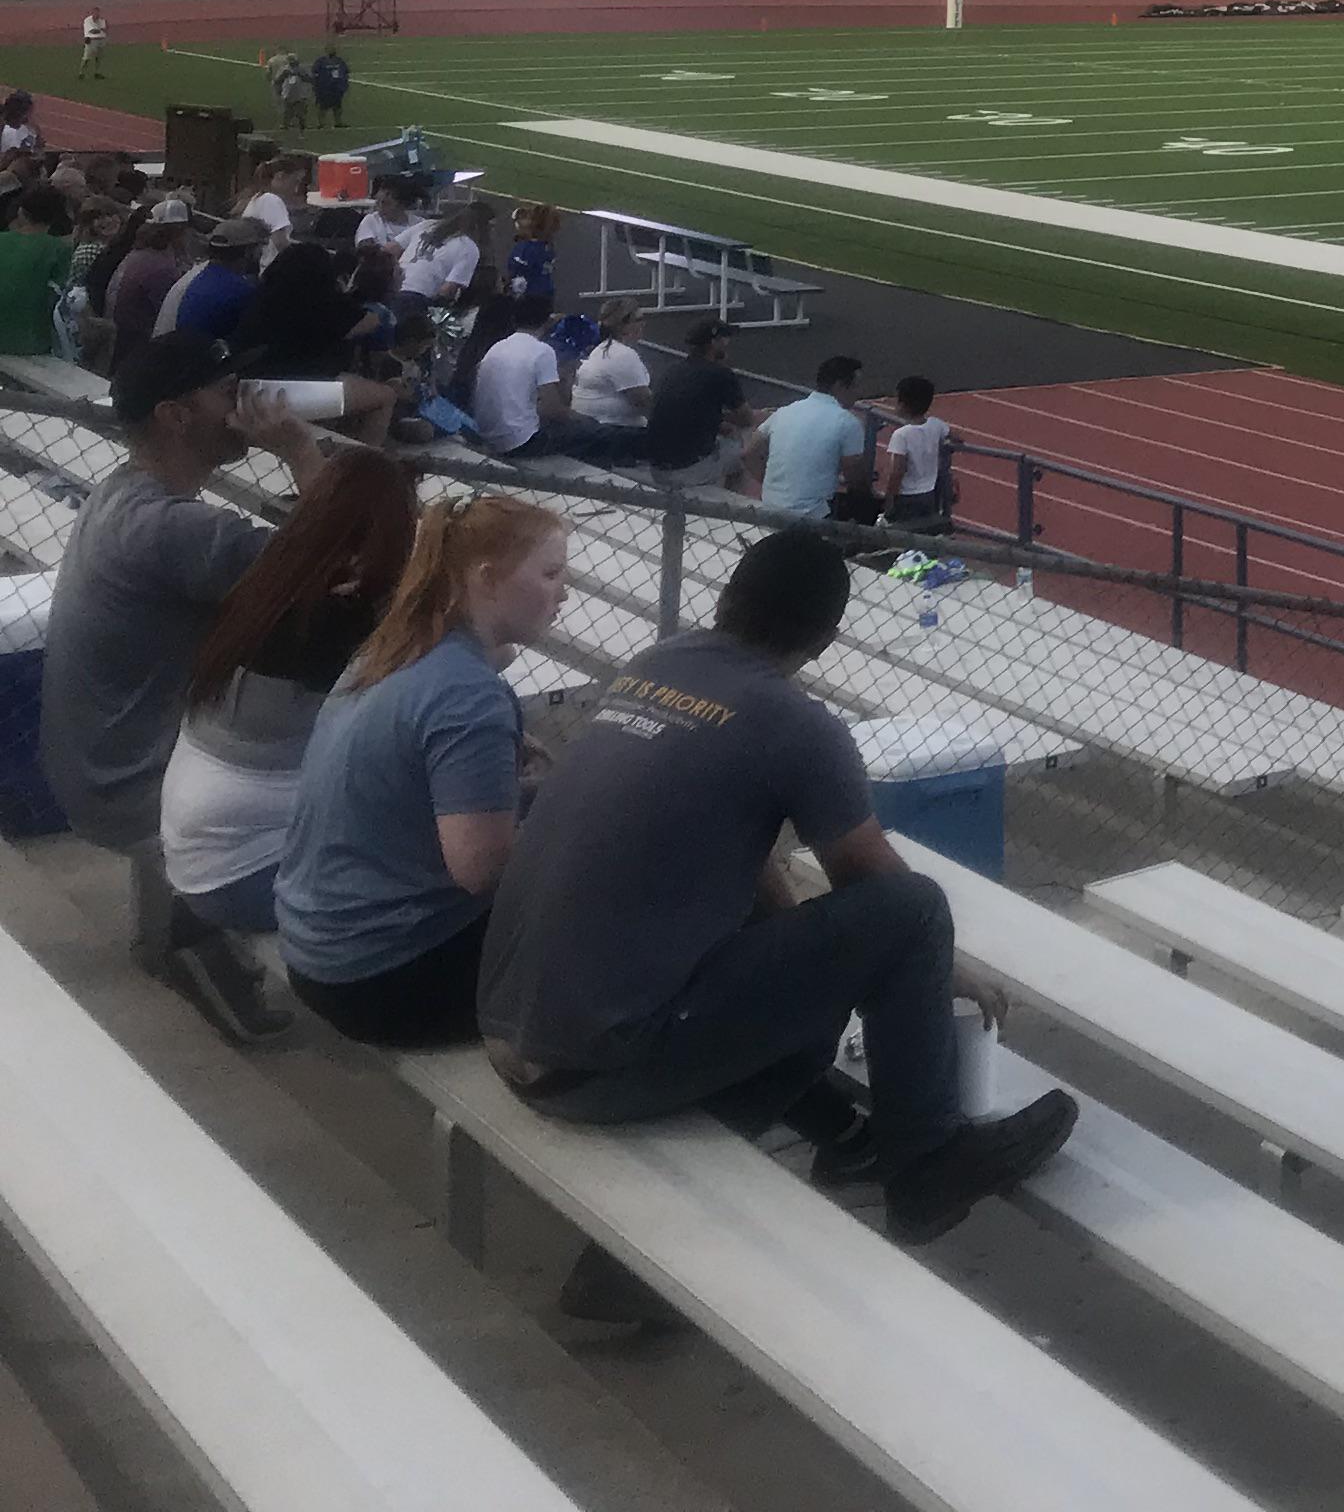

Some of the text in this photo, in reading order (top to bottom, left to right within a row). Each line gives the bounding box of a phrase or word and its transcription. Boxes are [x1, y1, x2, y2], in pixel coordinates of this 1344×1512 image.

[633, 679, 656, 699] IS
[651, 685, 737, 727] PRIORITY
[630, 713, 667, 736] TOOLS
